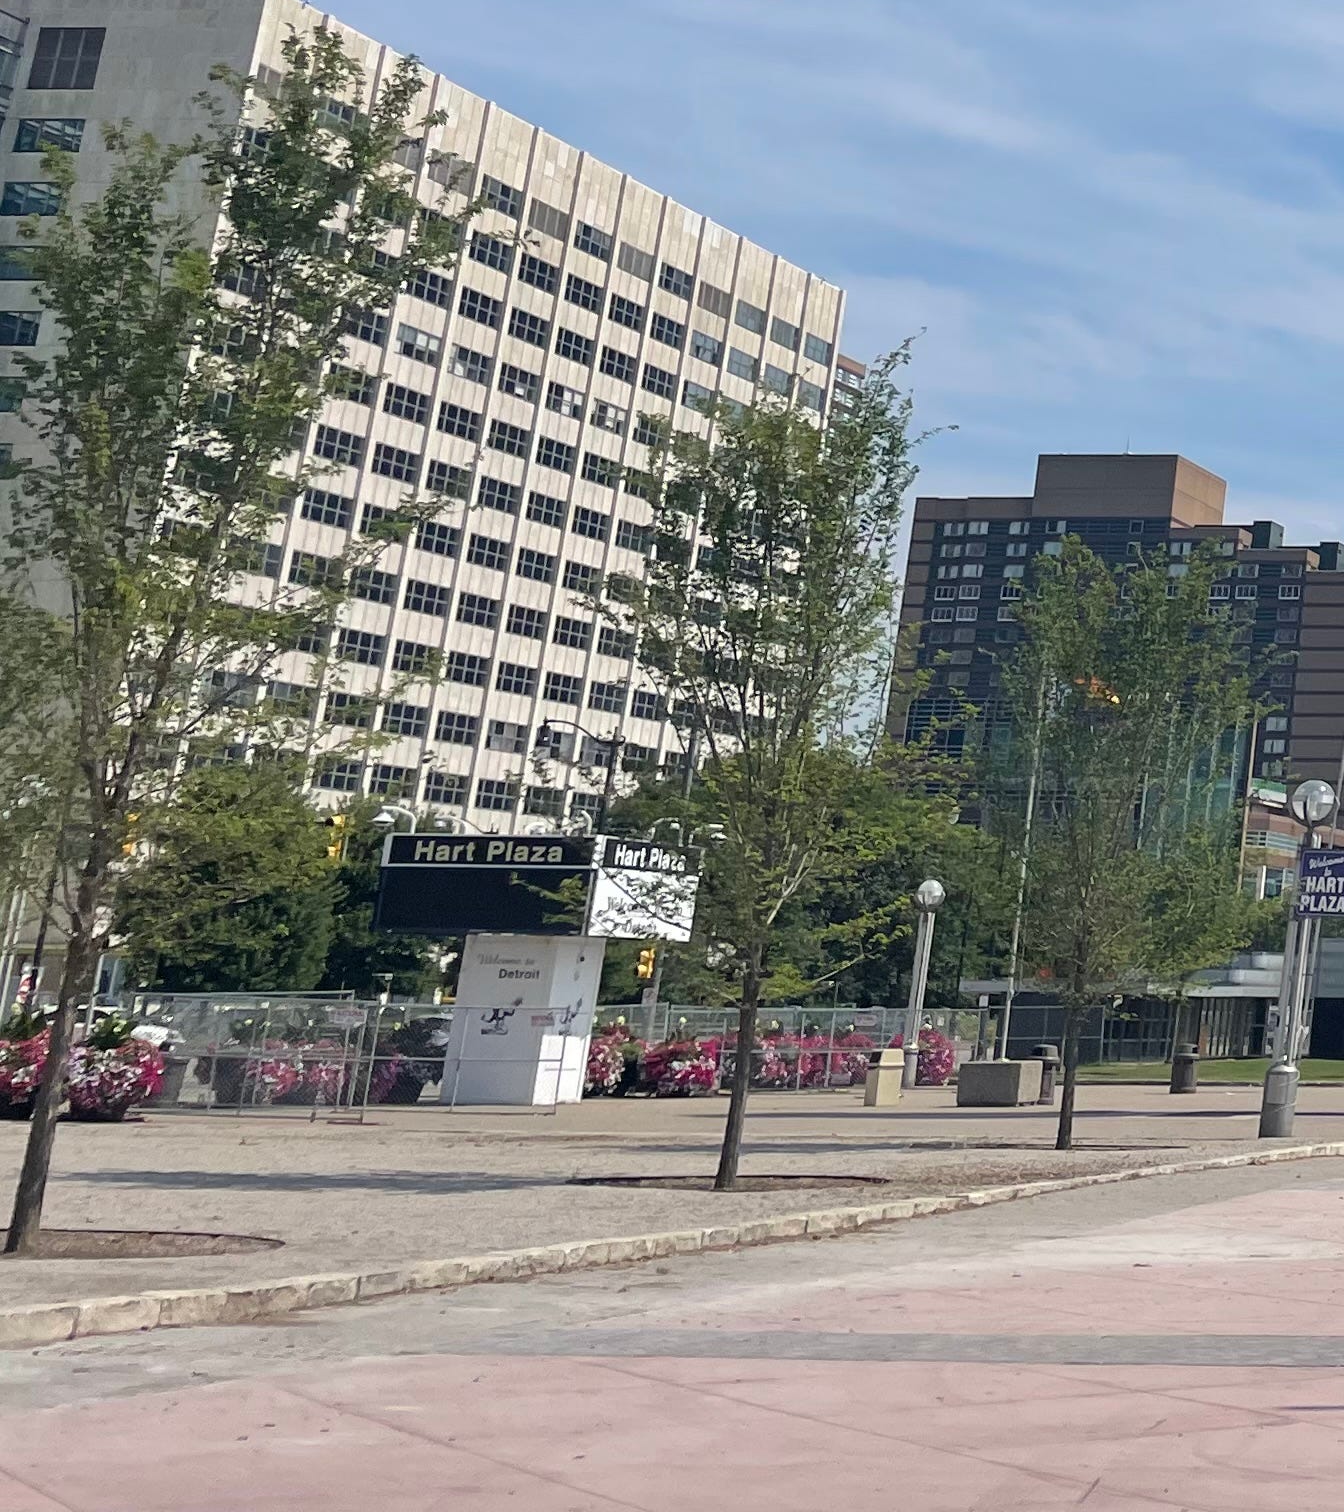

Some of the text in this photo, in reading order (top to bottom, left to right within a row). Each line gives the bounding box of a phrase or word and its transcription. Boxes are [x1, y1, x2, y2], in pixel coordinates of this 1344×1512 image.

[414, 840, 563, 863] Hart Plaza
[614, 843, 687, 872] Hart Plaza
[1309, 855, 1344, 870] Welcome
[498, 968, 540, 979] Detroit
